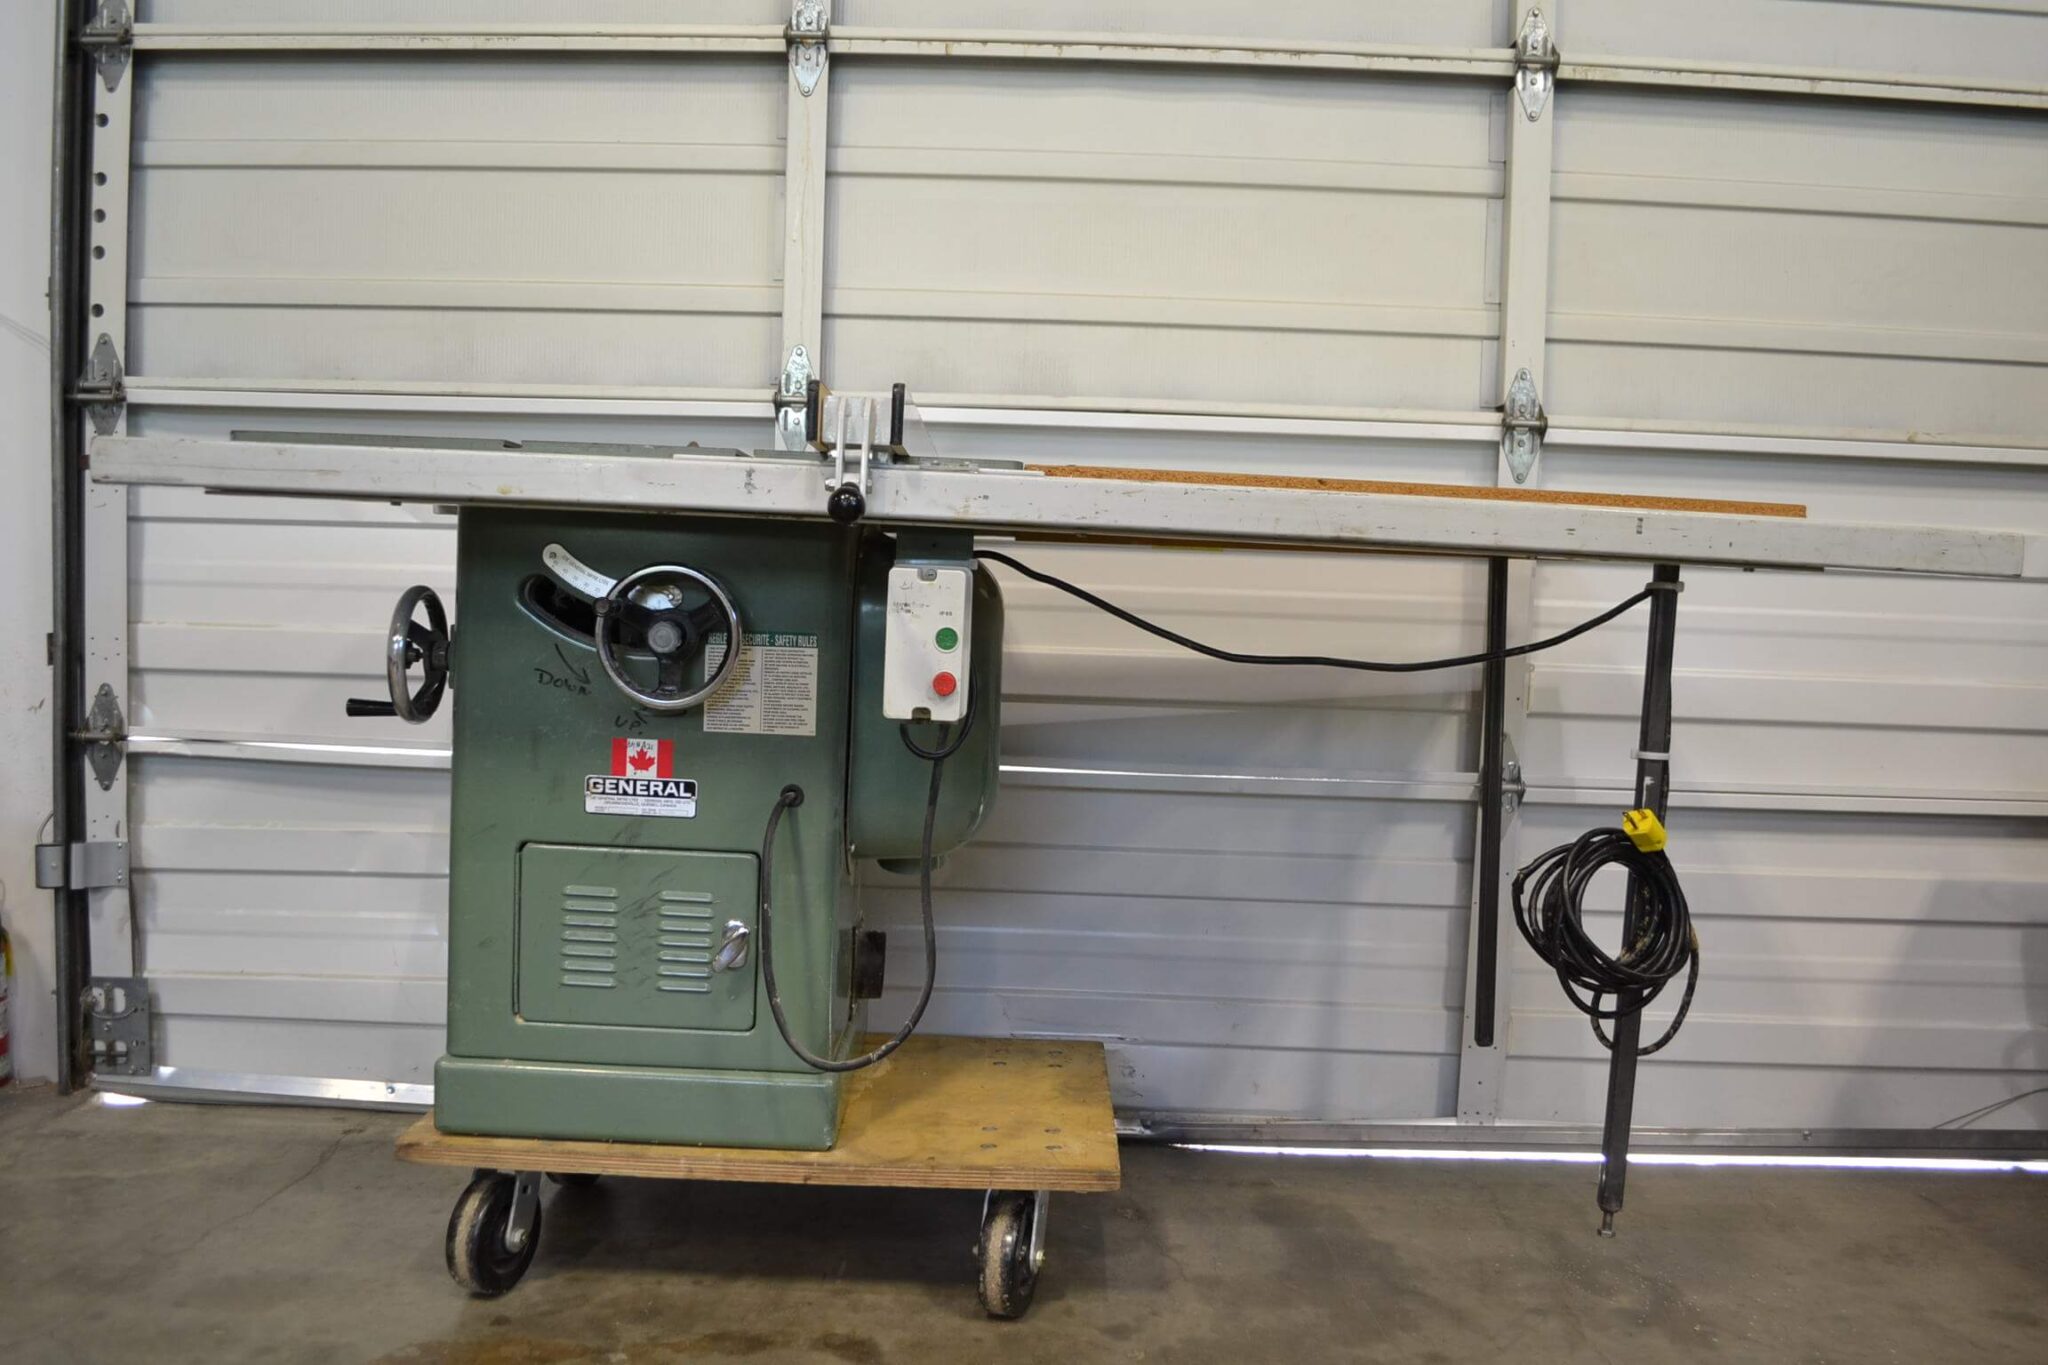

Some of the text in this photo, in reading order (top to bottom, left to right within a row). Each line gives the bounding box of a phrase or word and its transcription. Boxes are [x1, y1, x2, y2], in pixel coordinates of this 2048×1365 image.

[708, 632, 728, 644] REGLE
[774, 635, 797, 647] SAFETY
[797, 636, 817, 648] RULES
[589, 778, 692, 797] GENERAL
